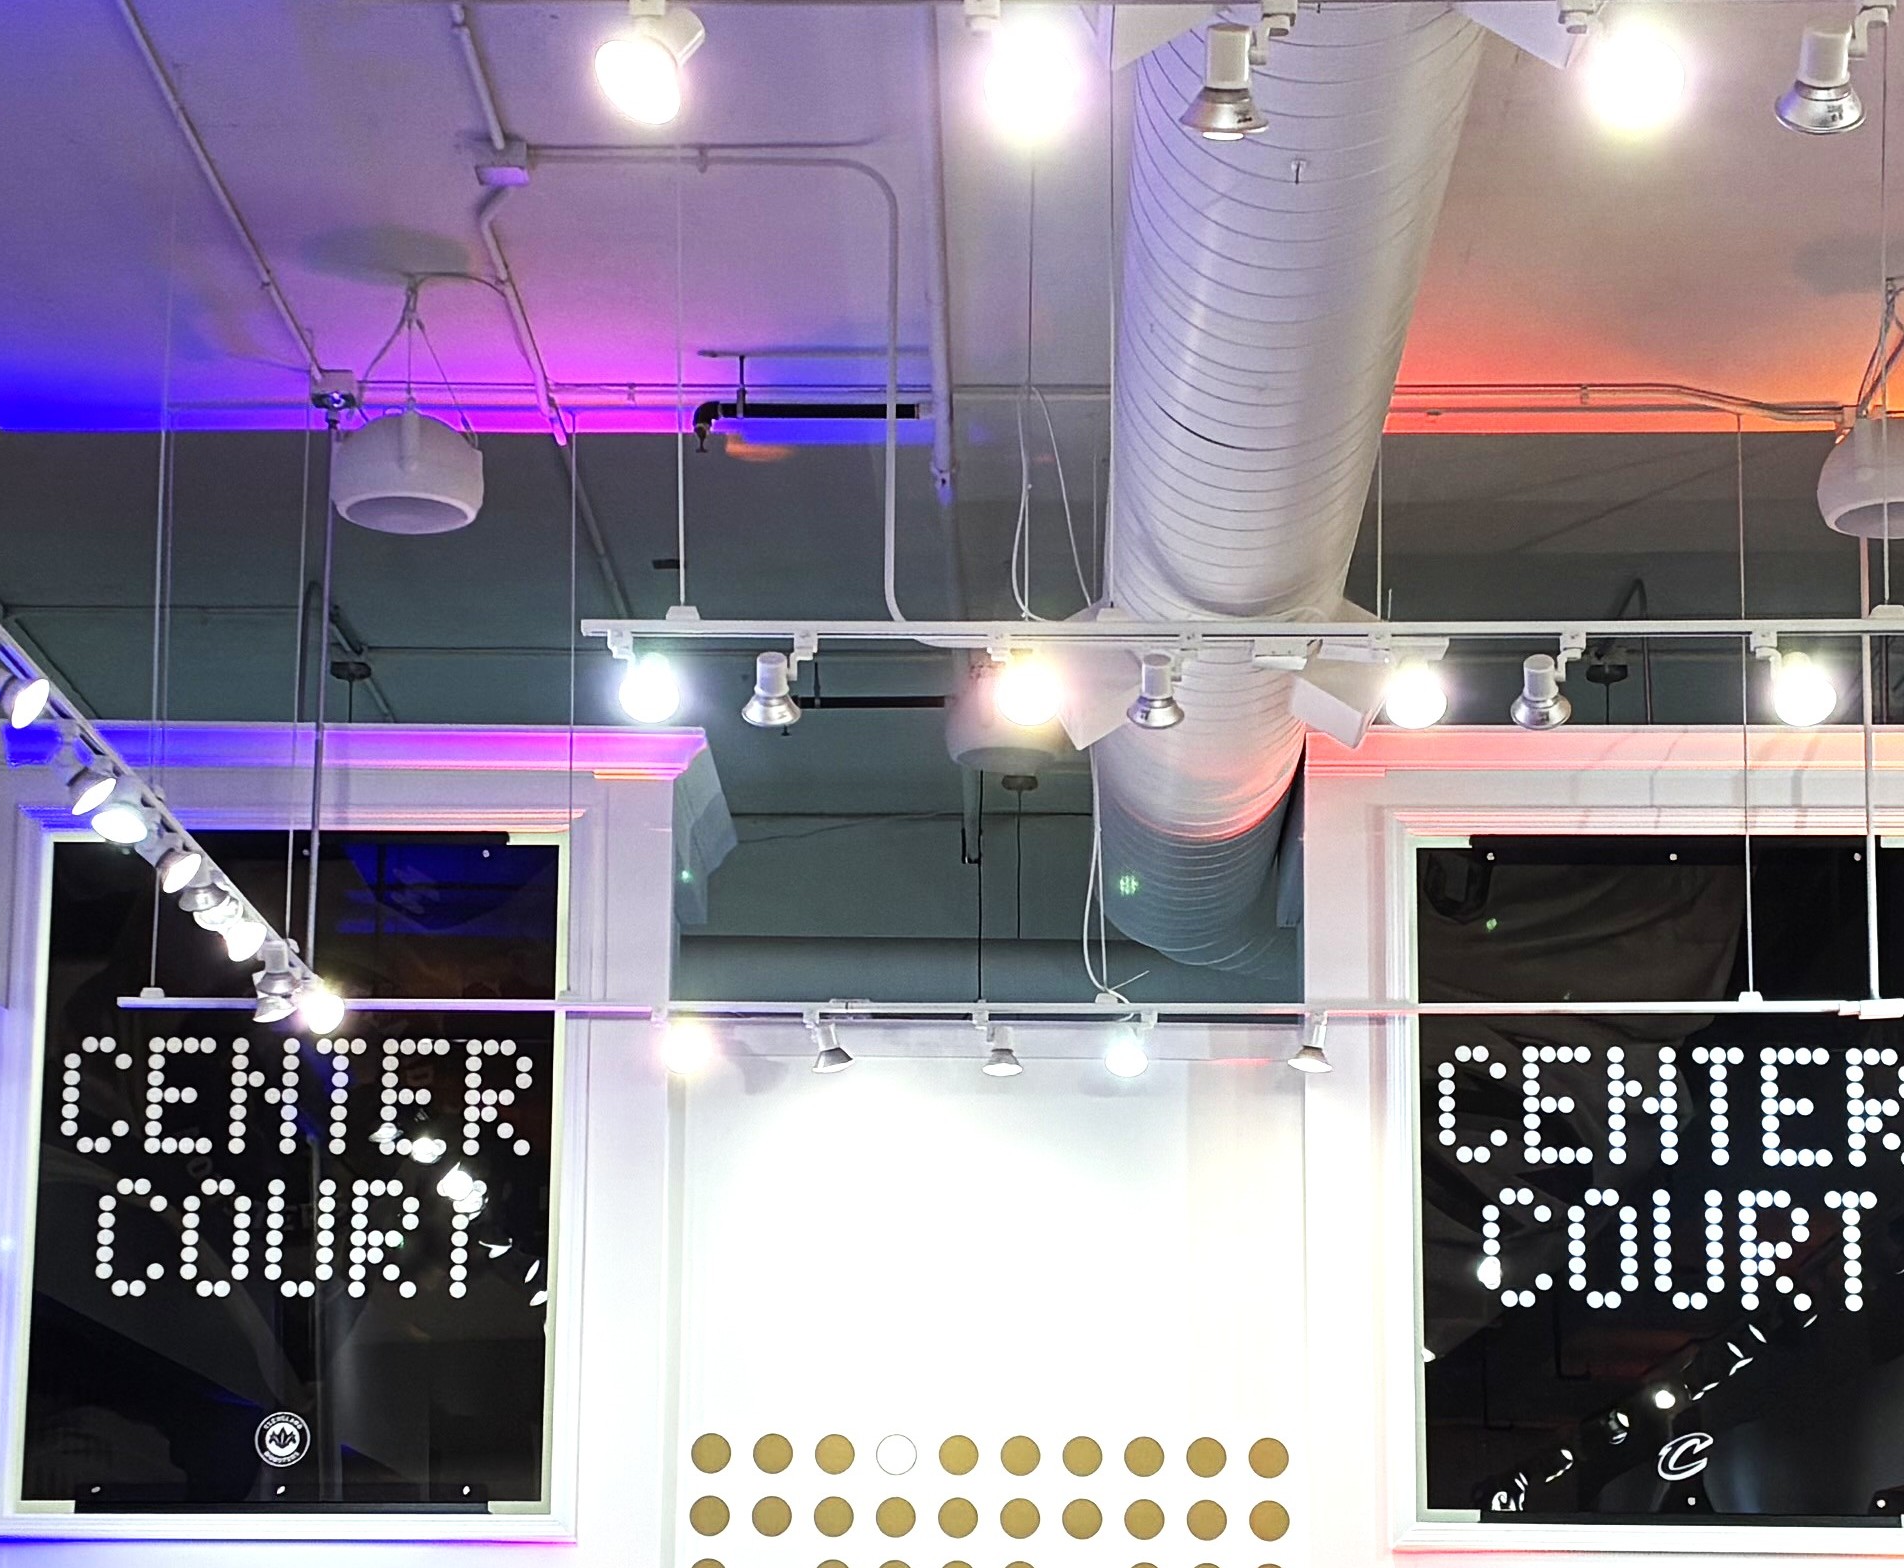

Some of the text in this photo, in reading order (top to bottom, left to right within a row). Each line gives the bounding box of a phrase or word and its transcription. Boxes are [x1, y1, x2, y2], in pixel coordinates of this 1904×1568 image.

[60, 1036, 532, 1156] CENTER
[95, 1178, 488, 1299] COURT
[1480, 1188, 1877, 1311] COURT
